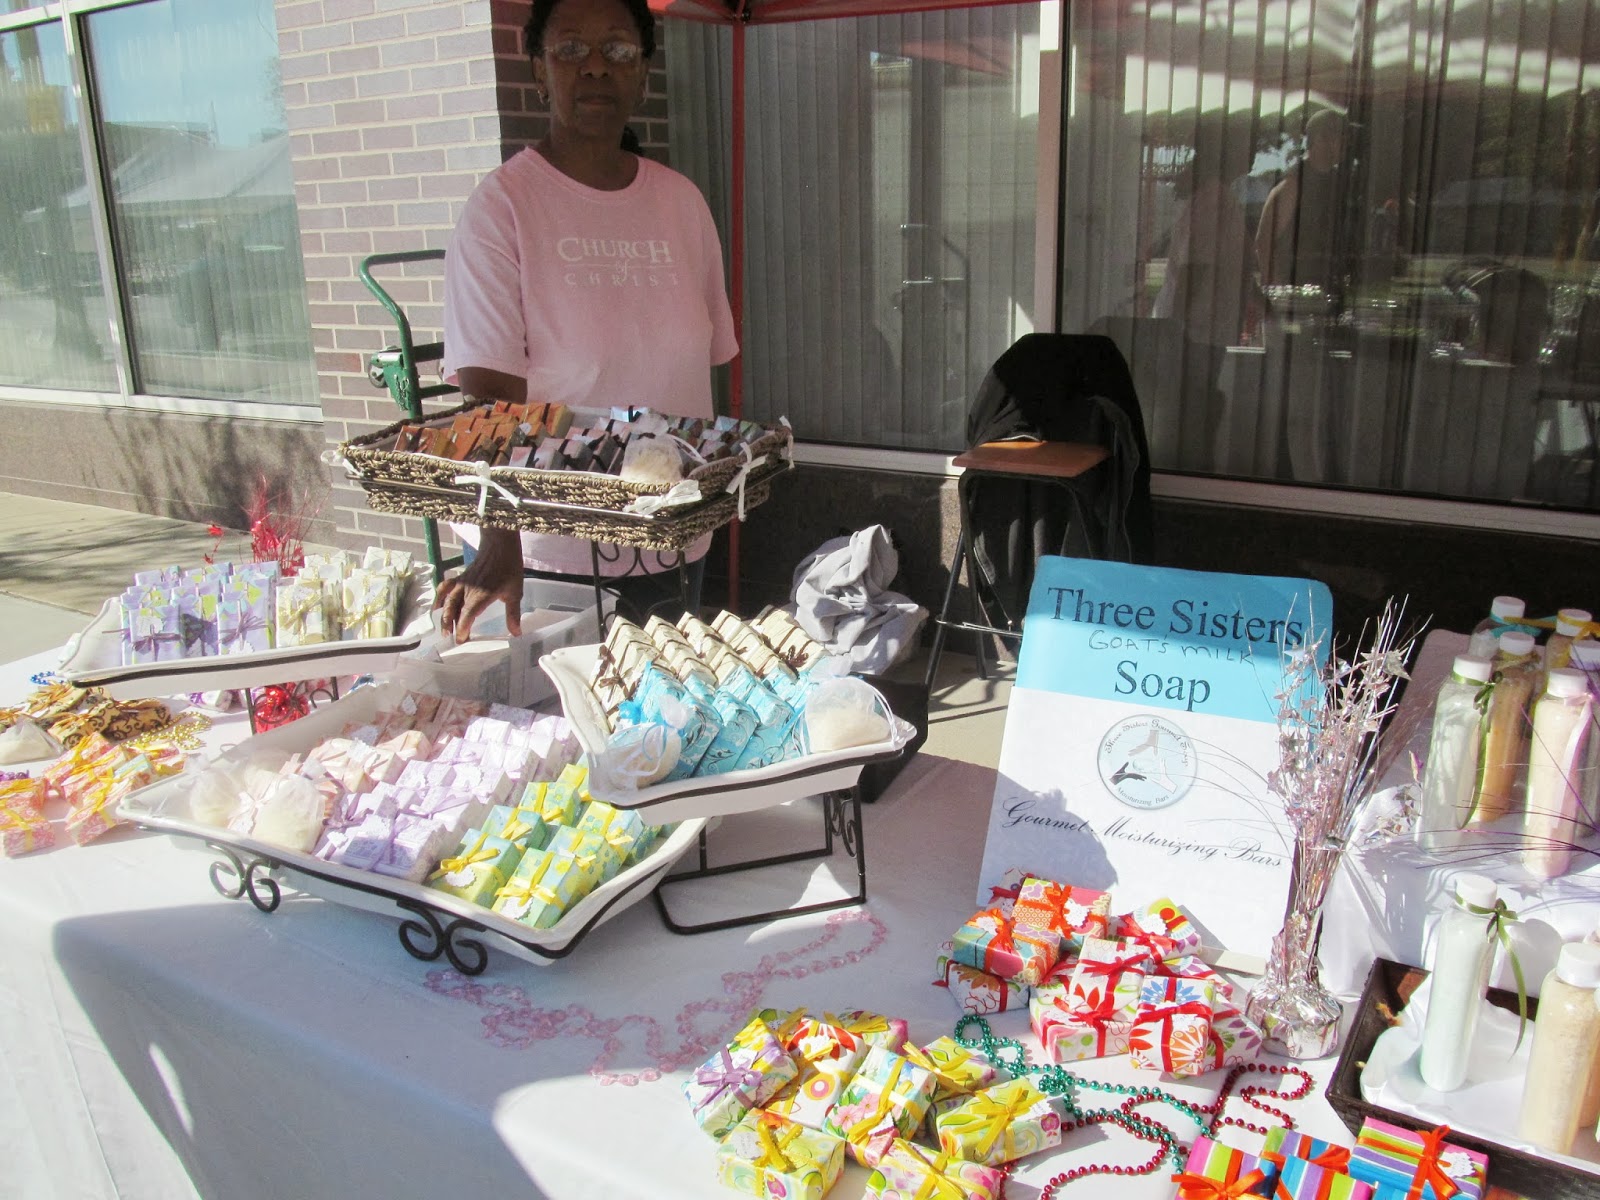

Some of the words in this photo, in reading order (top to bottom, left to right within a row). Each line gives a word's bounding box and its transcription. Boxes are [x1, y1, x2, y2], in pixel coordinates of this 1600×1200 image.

[557, 237, 673, 263] CHURCH
[564, 272, 679, 287] CHRIST
[1048, 587, 1156, 631] Three
[1169, 599, 1303, 646] Sisters
[1114, 660, 1211, 712] Soap
[1151, 718, 1182, 741] Gourmet
[1155, 794, 1170, 804] Bars
[1002, 797, 1090, 832] Gourmet
[1091, 815, 1219, 862] Moisturizing
[1224, 836, 1282, 867] Bars
